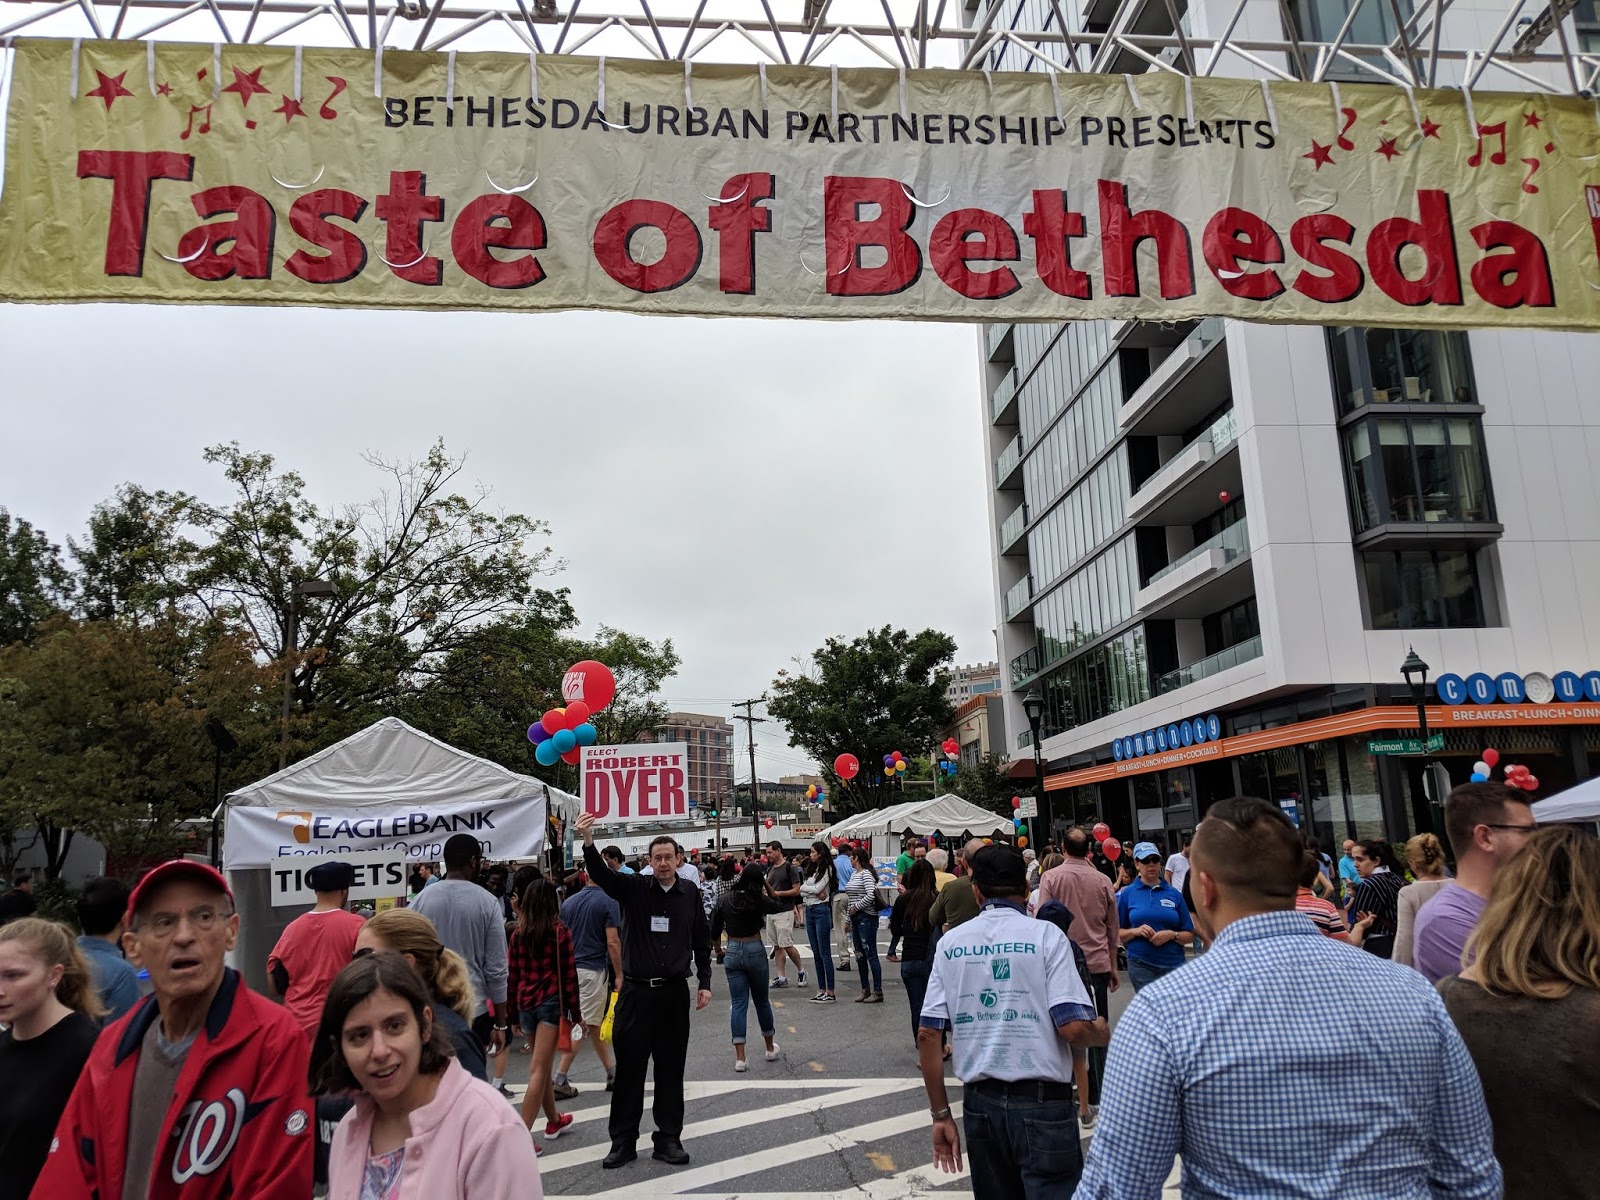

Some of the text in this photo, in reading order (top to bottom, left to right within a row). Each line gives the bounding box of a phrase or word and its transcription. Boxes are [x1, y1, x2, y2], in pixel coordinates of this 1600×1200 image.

[385, 96, 1276, 150] BETHESDA URBAN PARTNERSHIP PRESENTS
[77, 149, 1557, 308] Taste of Bethesda
[587, 748, 619, 756] ELECT
[1369, 742, 1404, 752] Fairmont
[585, 754, 684, 770] ROBERT
[585, 767, 686, 819] DYER
[274, 861, 403, 893] TICETS
[944, 942, 1036, 960] VOLUNTEER
